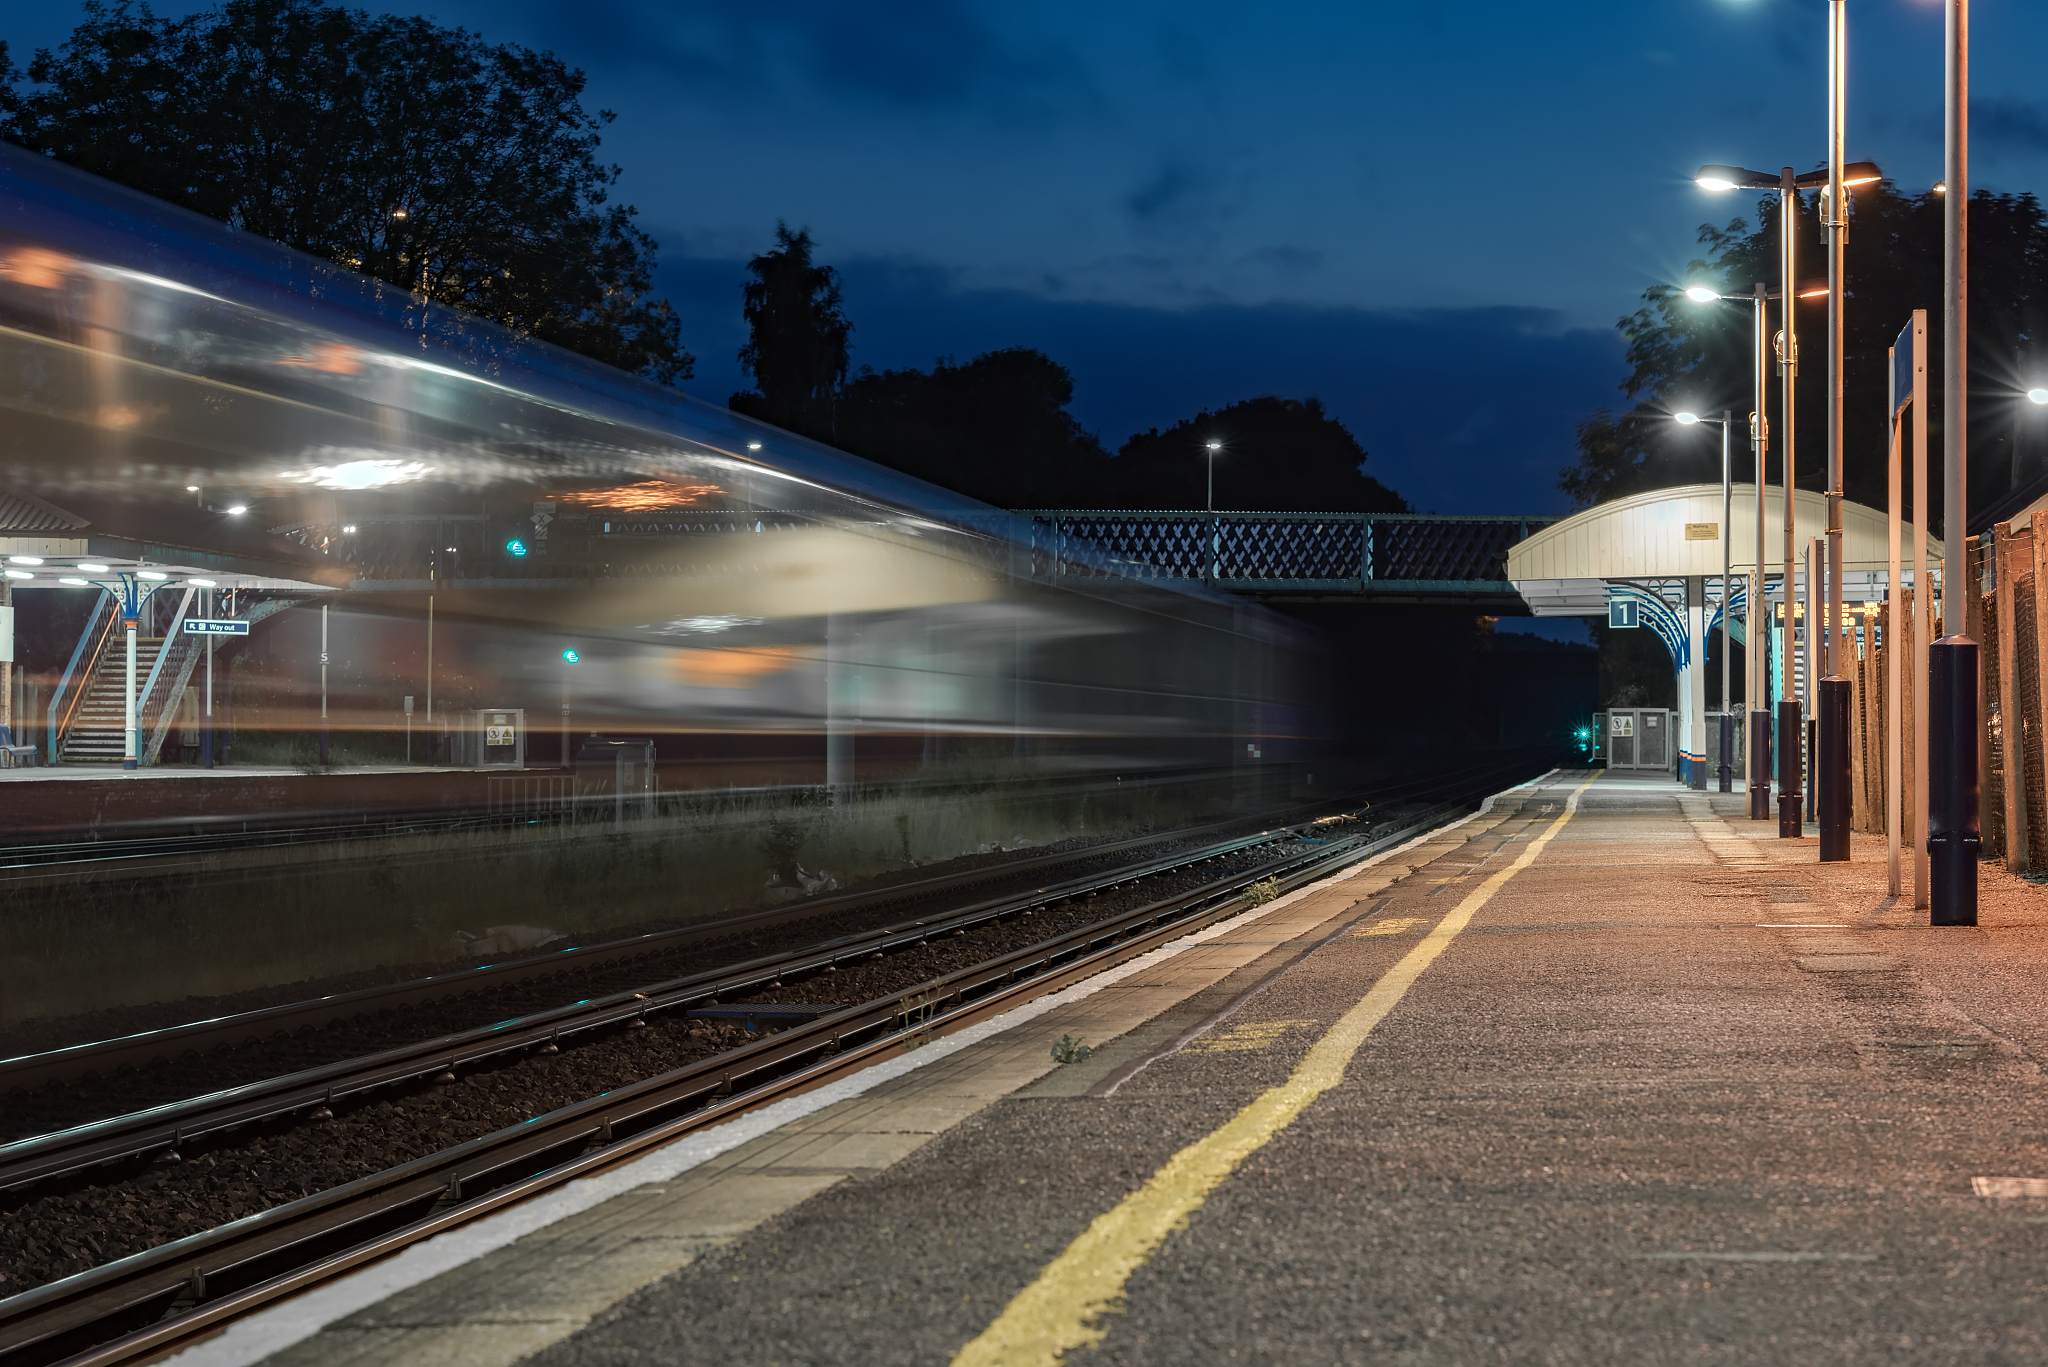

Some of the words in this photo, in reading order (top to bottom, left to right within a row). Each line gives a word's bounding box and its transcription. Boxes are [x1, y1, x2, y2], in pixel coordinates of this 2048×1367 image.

[1619, 603, 1628, 624] 1
[209, 624, 223, 632] Way
[321, 652, 328, 661] S
